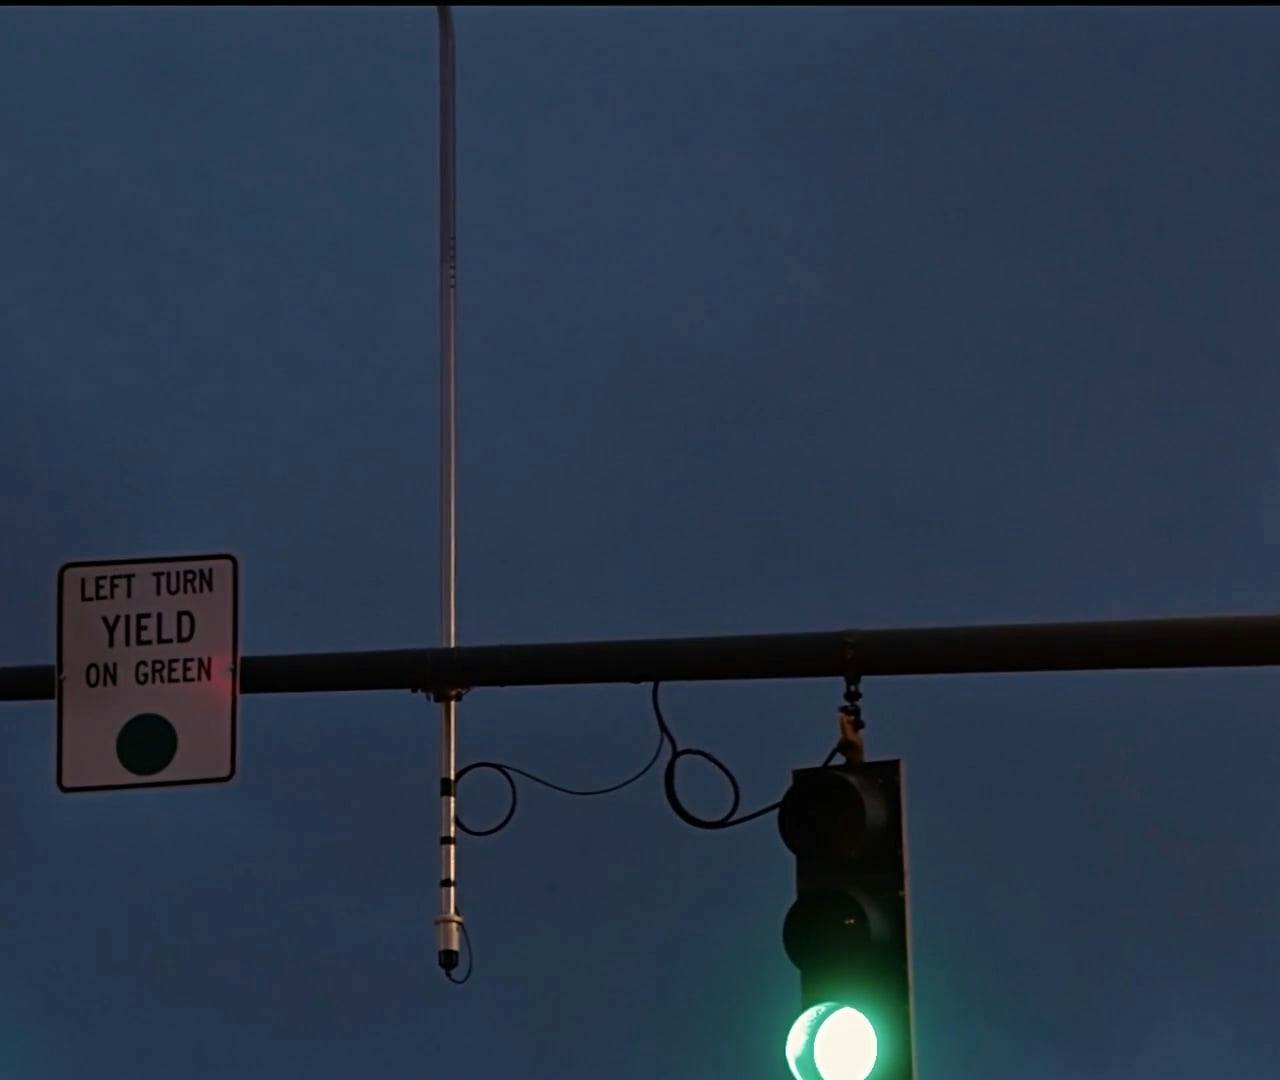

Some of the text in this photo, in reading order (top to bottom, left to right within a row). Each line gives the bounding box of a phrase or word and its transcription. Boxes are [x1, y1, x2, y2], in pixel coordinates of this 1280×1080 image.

[81, 568, 213, 602] LEFT TURN
[102, 610, 196, 648] YIELD
[85, 657, 212, 688] ON GREEN
